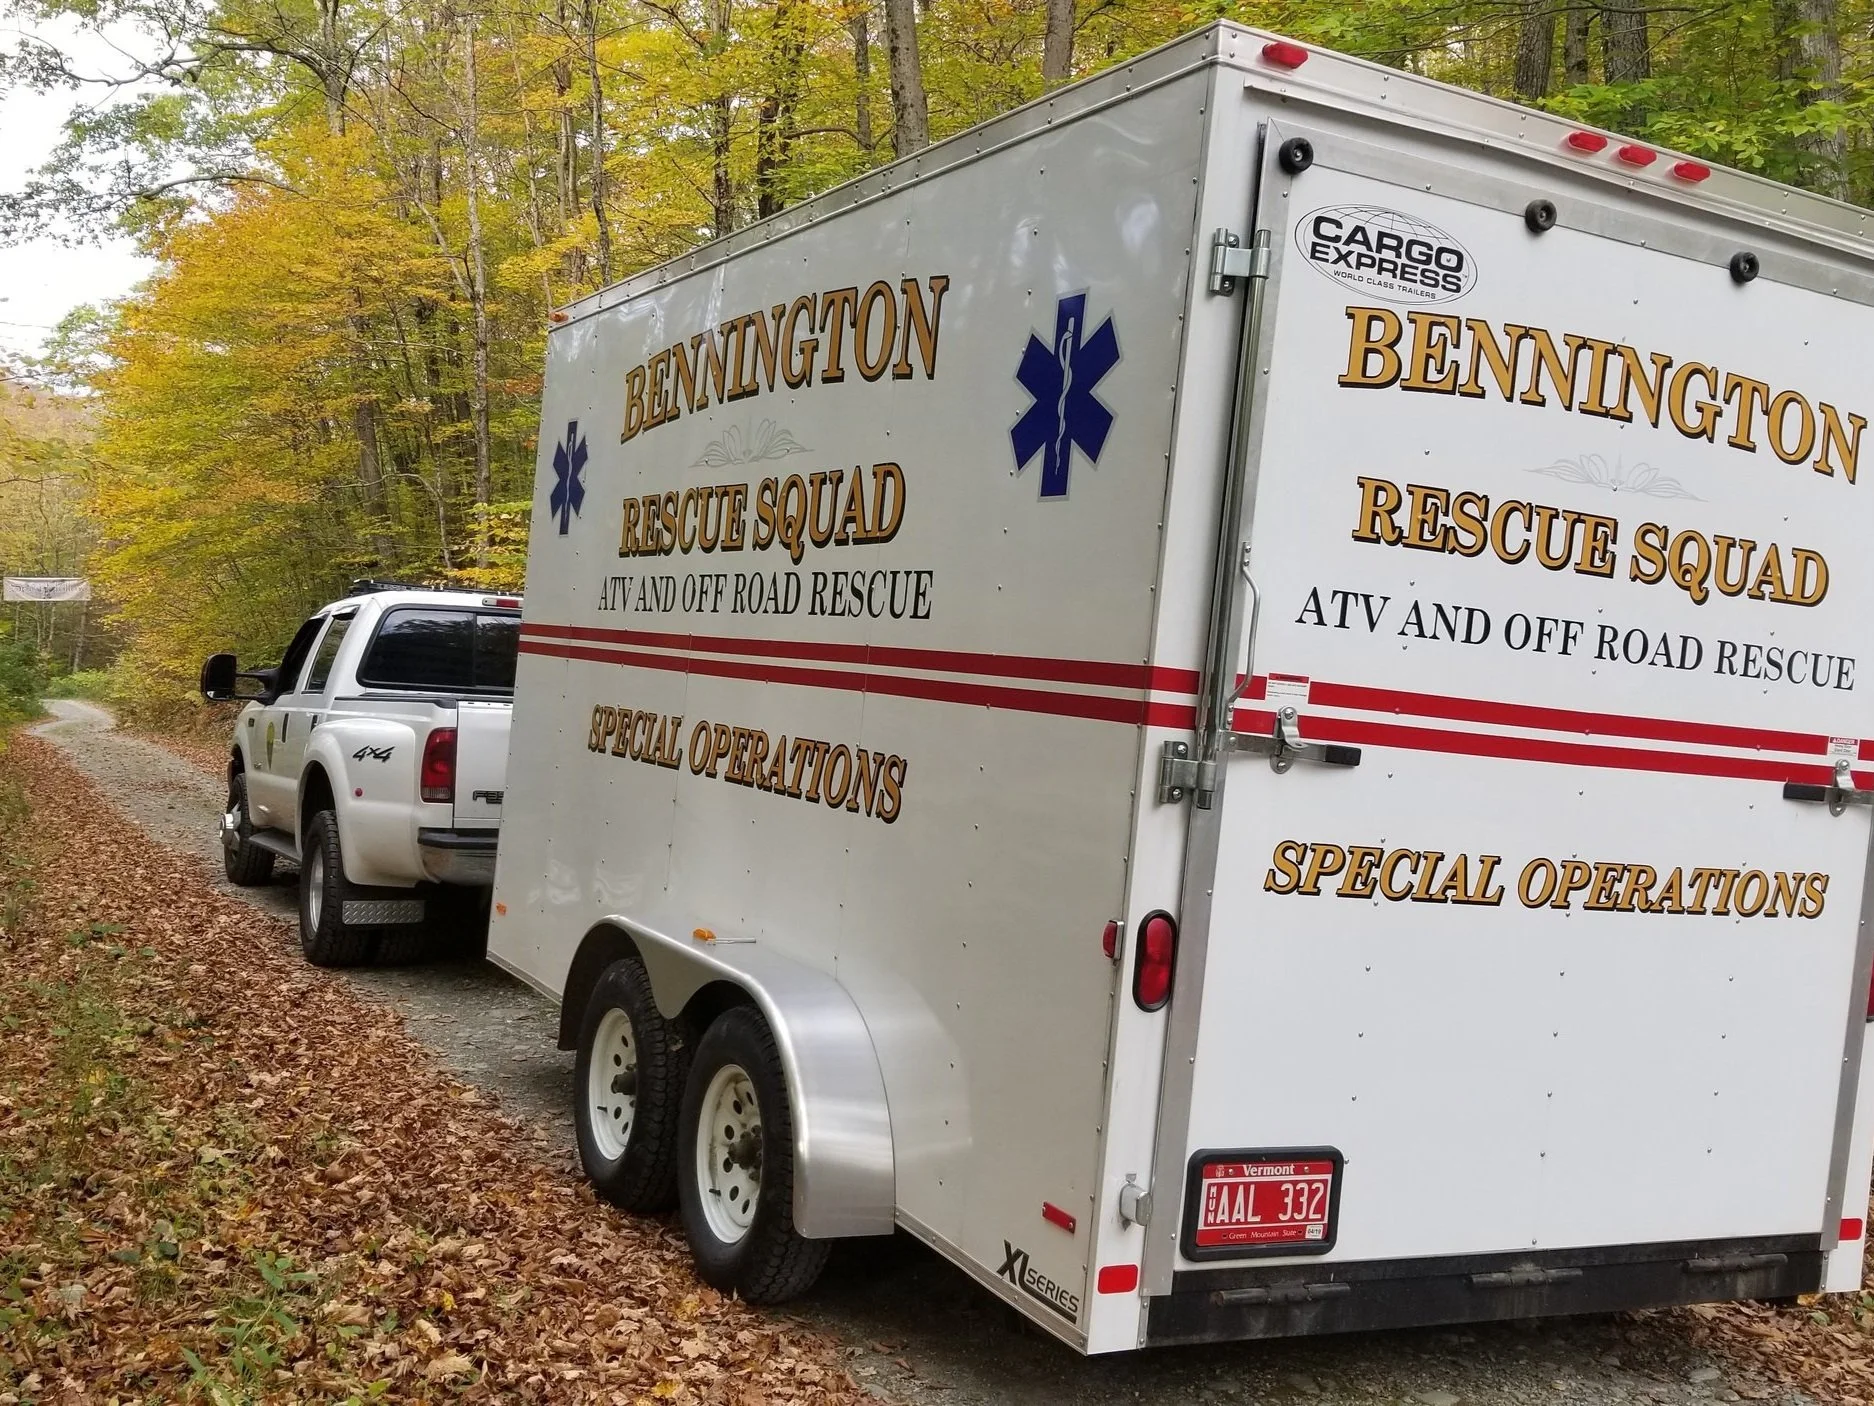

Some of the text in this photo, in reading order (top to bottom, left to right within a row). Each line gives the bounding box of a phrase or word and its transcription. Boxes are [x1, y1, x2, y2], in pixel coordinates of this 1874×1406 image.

[1309, 242, 1461, 294] EXPRESS
[1312, 215, 1465, 275] CARGO
[1333, 269, 1436, 299] WORLD CLASS TRAILERS
[621, 275, 949, 445] BENNINGTON
[1337, 306, 1868, 485] BENNINGTON
[619, 462, 906, 565] RESCUE SQUAD
[1352, 476, 1830, 607] RESCUE SQUAD
[598, 570, 934, 620] ATV AND OFF ROAD RESCUE
[1295, 586, 1856, 692] ATV AND OFF ROAD RESCUE
[588, 703, 907, 824] SPECIAL OPERATIONS
[1264, 840, 1829, 920] SPECIAL OPERATIONS
[1243, 1164, 1295, 1177] Vermont
[1207, 1185, 1218, 1224] MUN
[1216, 1182, 1325, 1224] AAL 332
[1228, 1232, 1247, 1240] Green
[1250, 1230, 1280, 1240] Mountain
